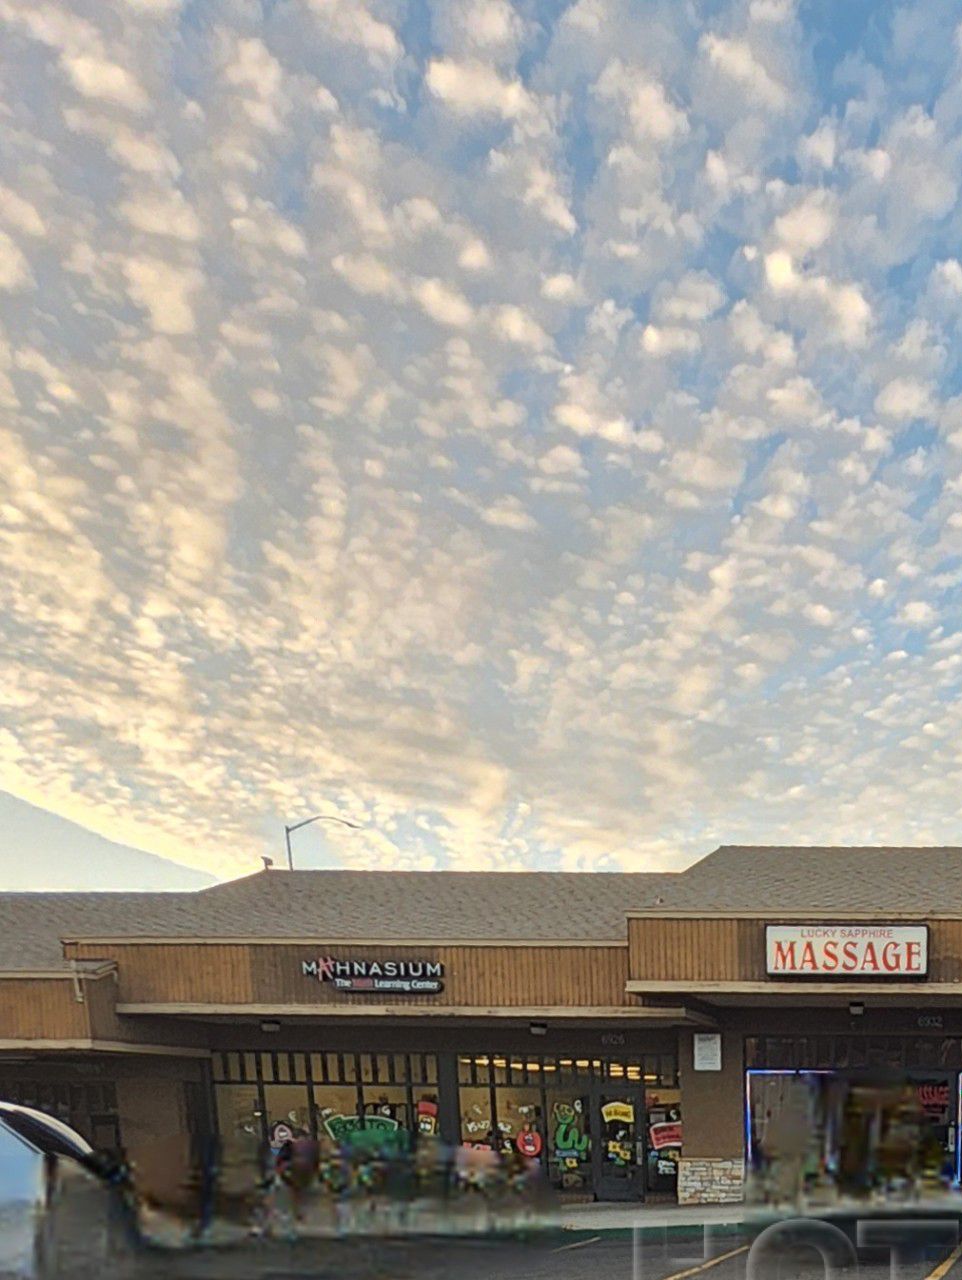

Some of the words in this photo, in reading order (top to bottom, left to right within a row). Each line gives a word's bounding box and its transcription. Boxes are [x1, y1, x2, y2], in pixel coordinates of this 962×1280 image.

[801, 929, 837, 938] LUCKY
[840, 929, 894, 938] SAPPHIRE
[774, 941, 921, 971] MASSAGE
[302, 956, 441, 981] MATHNASIUM
[335, 978, 352, 988] The
[374, 979, 411, 990] Learning
[411, 979, 439, 989] Center
